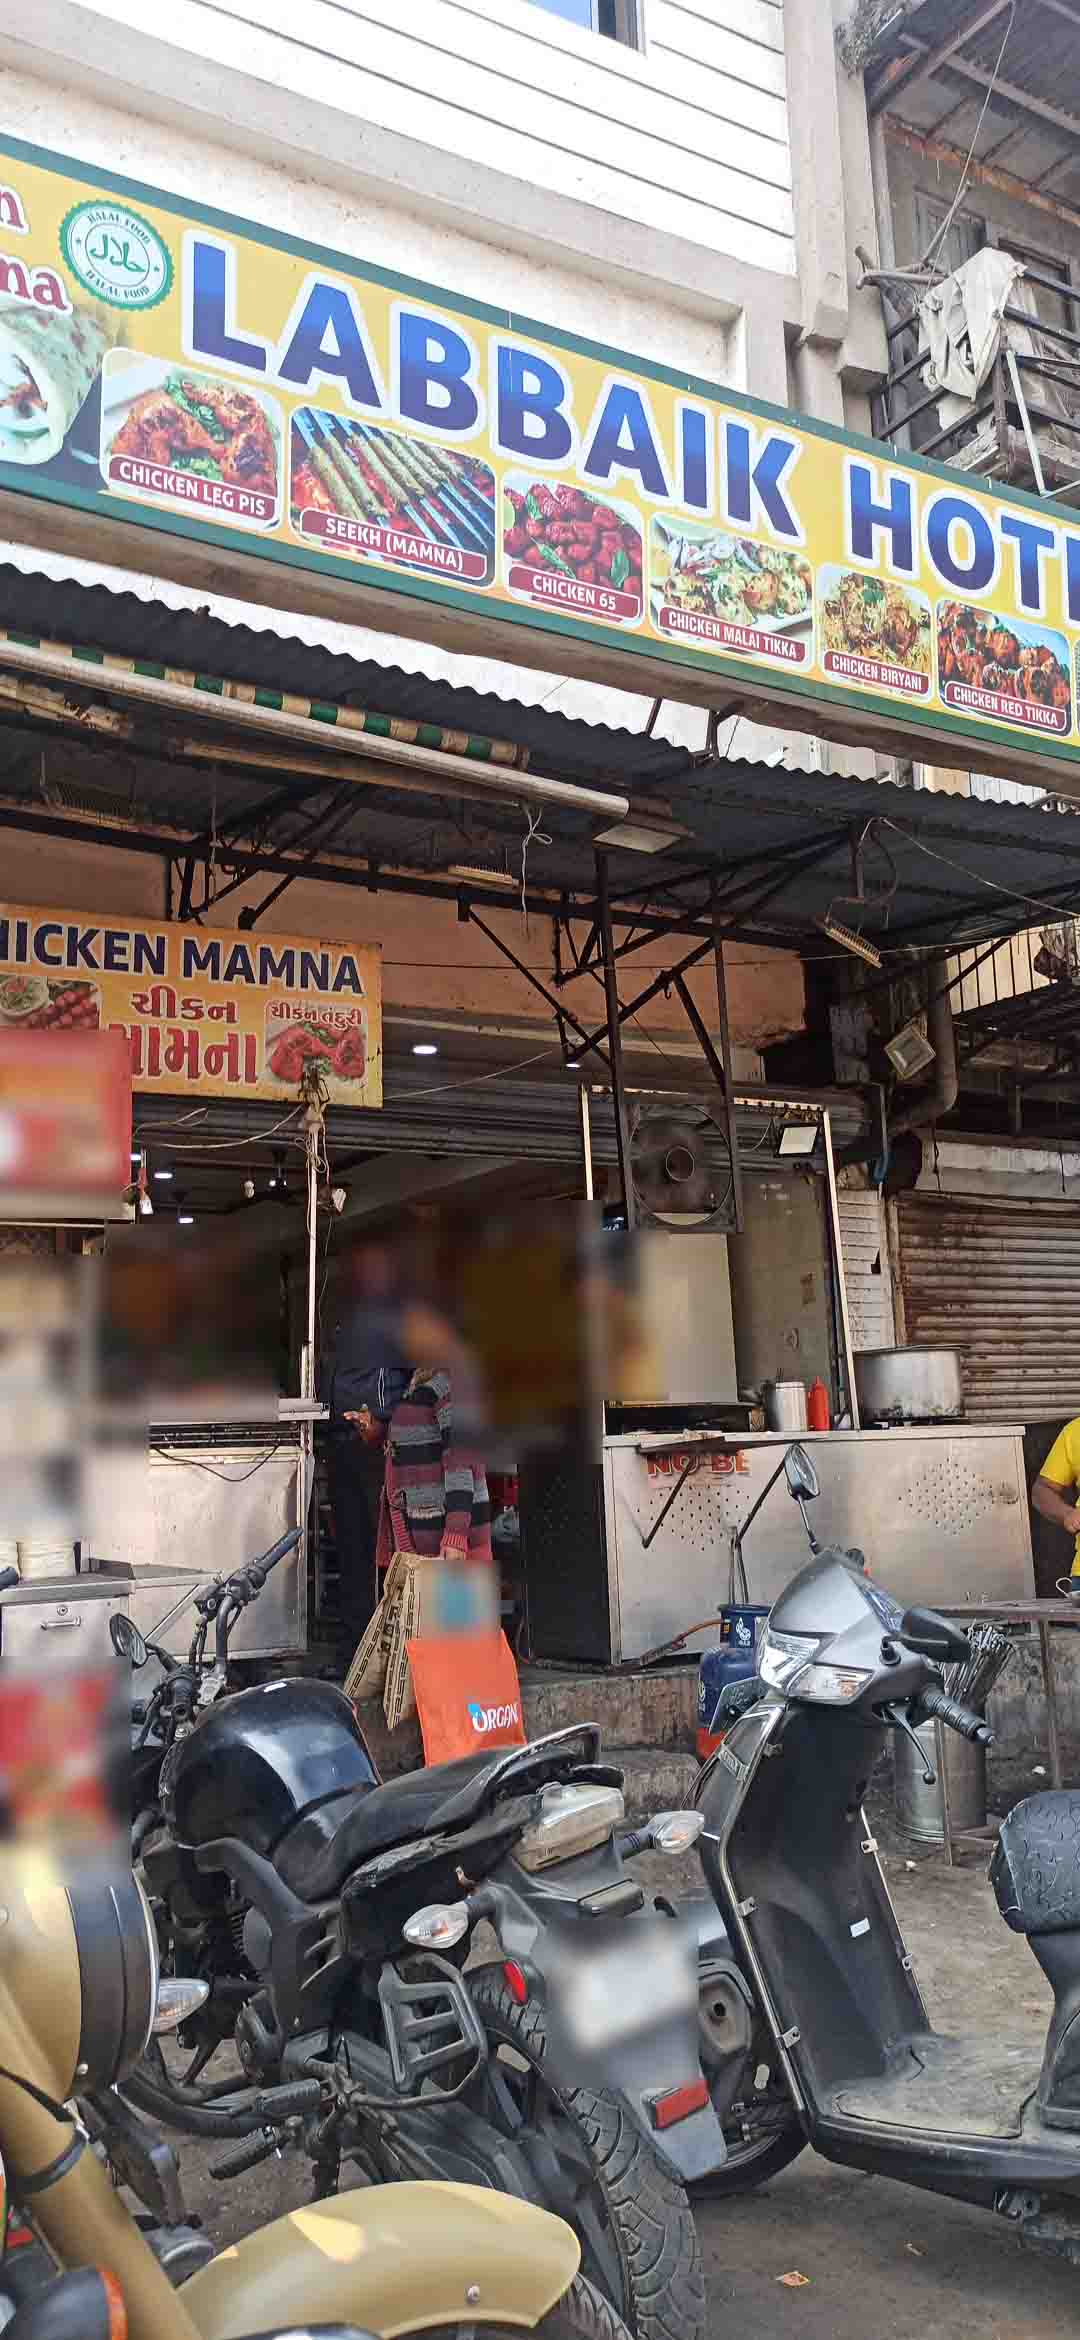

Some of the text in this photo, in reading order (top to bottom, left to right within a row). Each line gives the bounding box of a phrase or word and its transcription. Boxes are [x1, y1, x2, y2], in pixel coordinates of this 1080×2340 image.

[89, 233, 147, 273] حلال
[191, 240, 804, 541] LABBAIK
[119, 461, 265, 516] CHICKEN LEG PIS
[325, 517, 463, 571] SEEKH (MAMNA)
[532, 575, 616, 610] CHICKEN 65
[668, 611, 797, 659] CHICKEN MALAI TIKKA
[832, 655, 922, 691] CHICKEN BIRYANI
[953, 686, 1058, 727] CHICKEN RED TIKKA
[183, 938, 365, 996] MAMNA
[131, 985, 237, 1024] ચીકન
[271, 1002, 317, 1021] ચીકન
